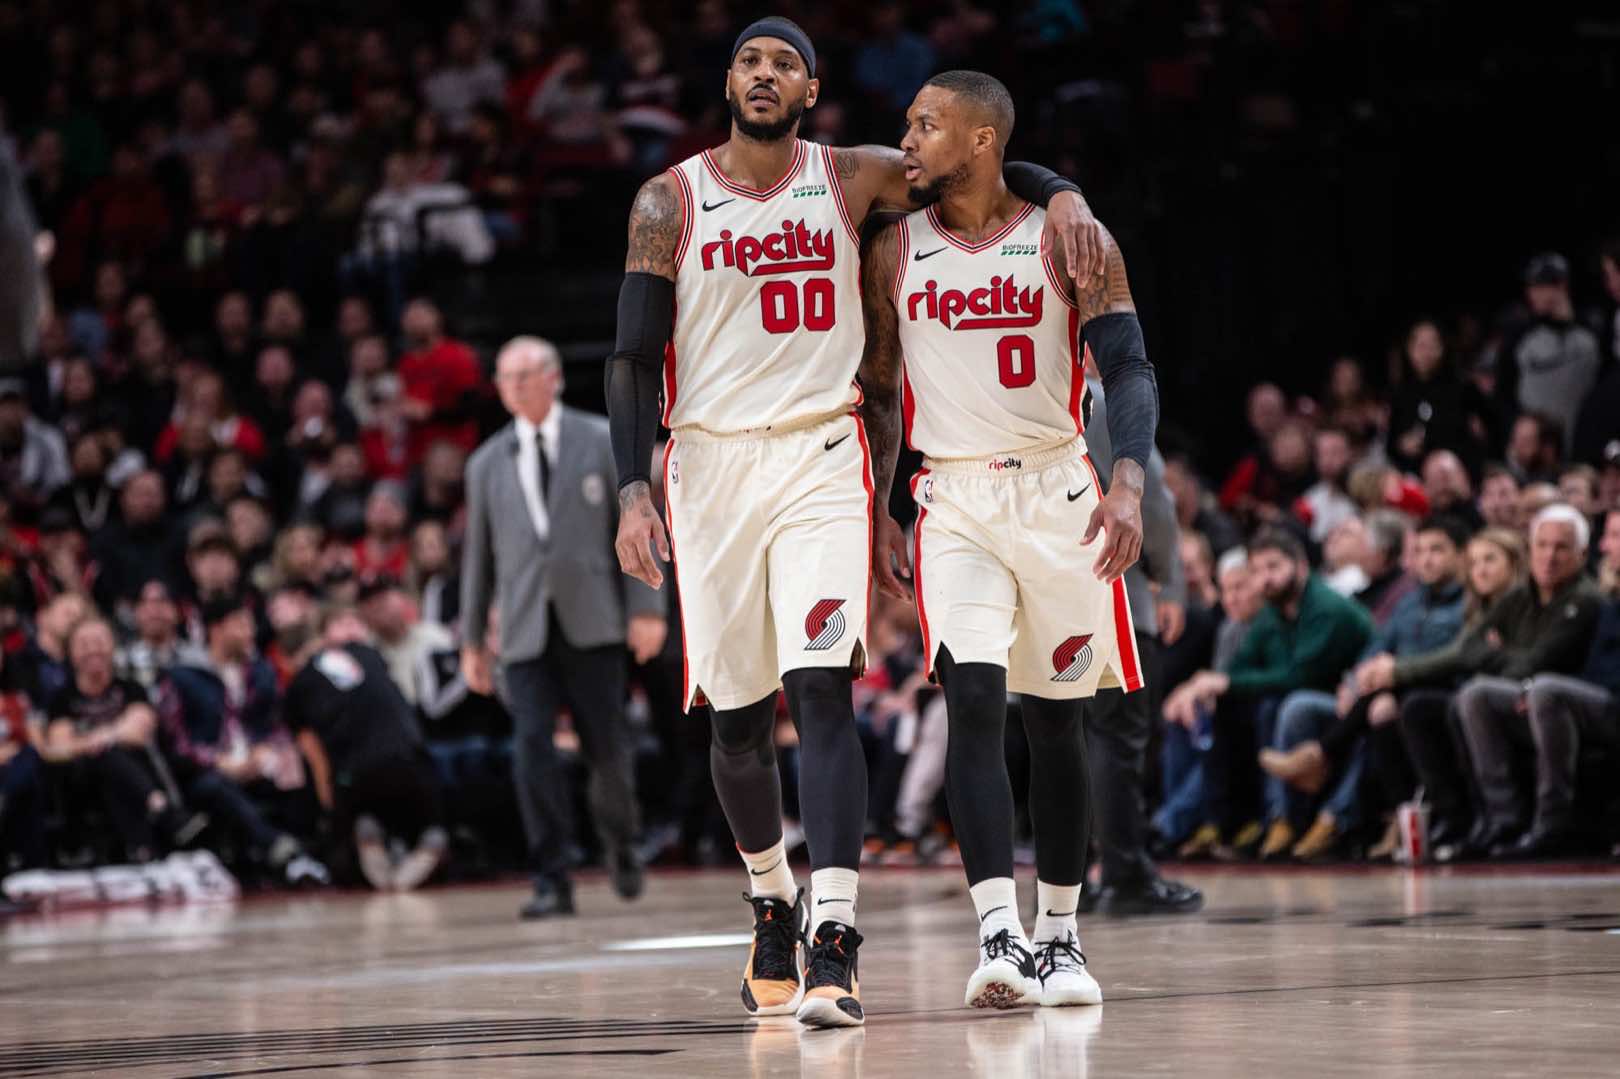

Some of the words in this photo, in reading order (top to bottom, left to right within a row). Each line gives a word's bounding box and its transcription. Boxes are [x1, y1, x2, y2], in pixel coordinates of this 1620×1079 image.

[701, 218, 835, 277] ripcity
[760, 278, 835, 333] 00
[908, 274, 1043, 330] ripcity
[997, 335, 1036, 389] 0
[988, 457, 1022, 471] ripcity
